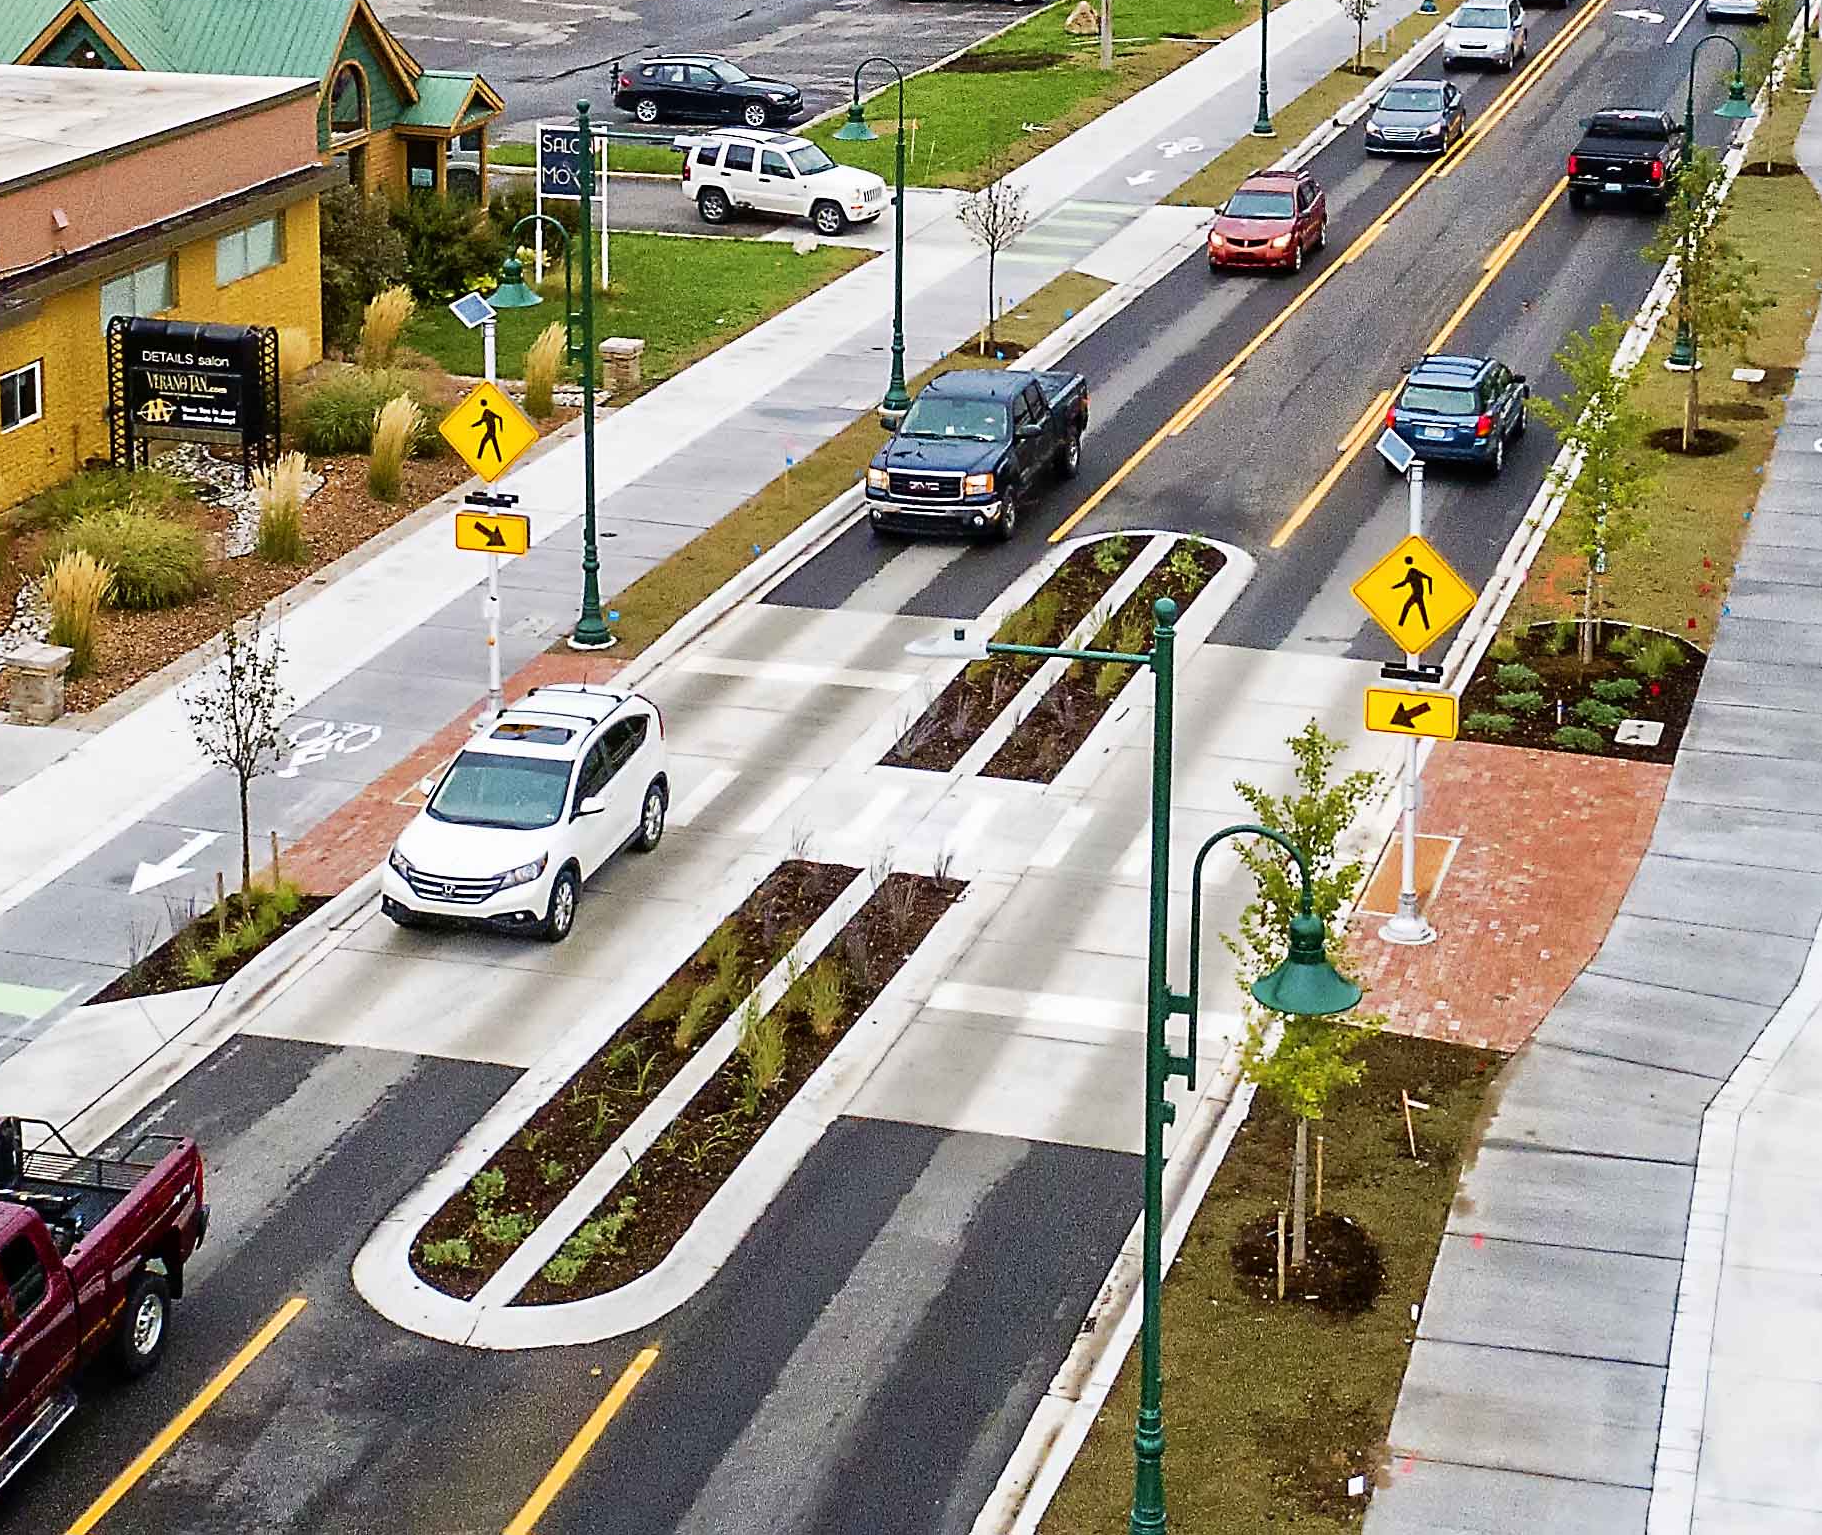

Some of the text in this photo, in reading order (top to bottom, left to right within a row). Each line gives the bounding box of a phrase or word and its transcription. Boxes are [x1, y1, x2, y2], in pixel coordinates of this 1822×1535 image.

[542, 159, 594, 190] MOX
[142, 350, 229, 368] DETAILS salon
[146, 371, 187, 391] VERANO
